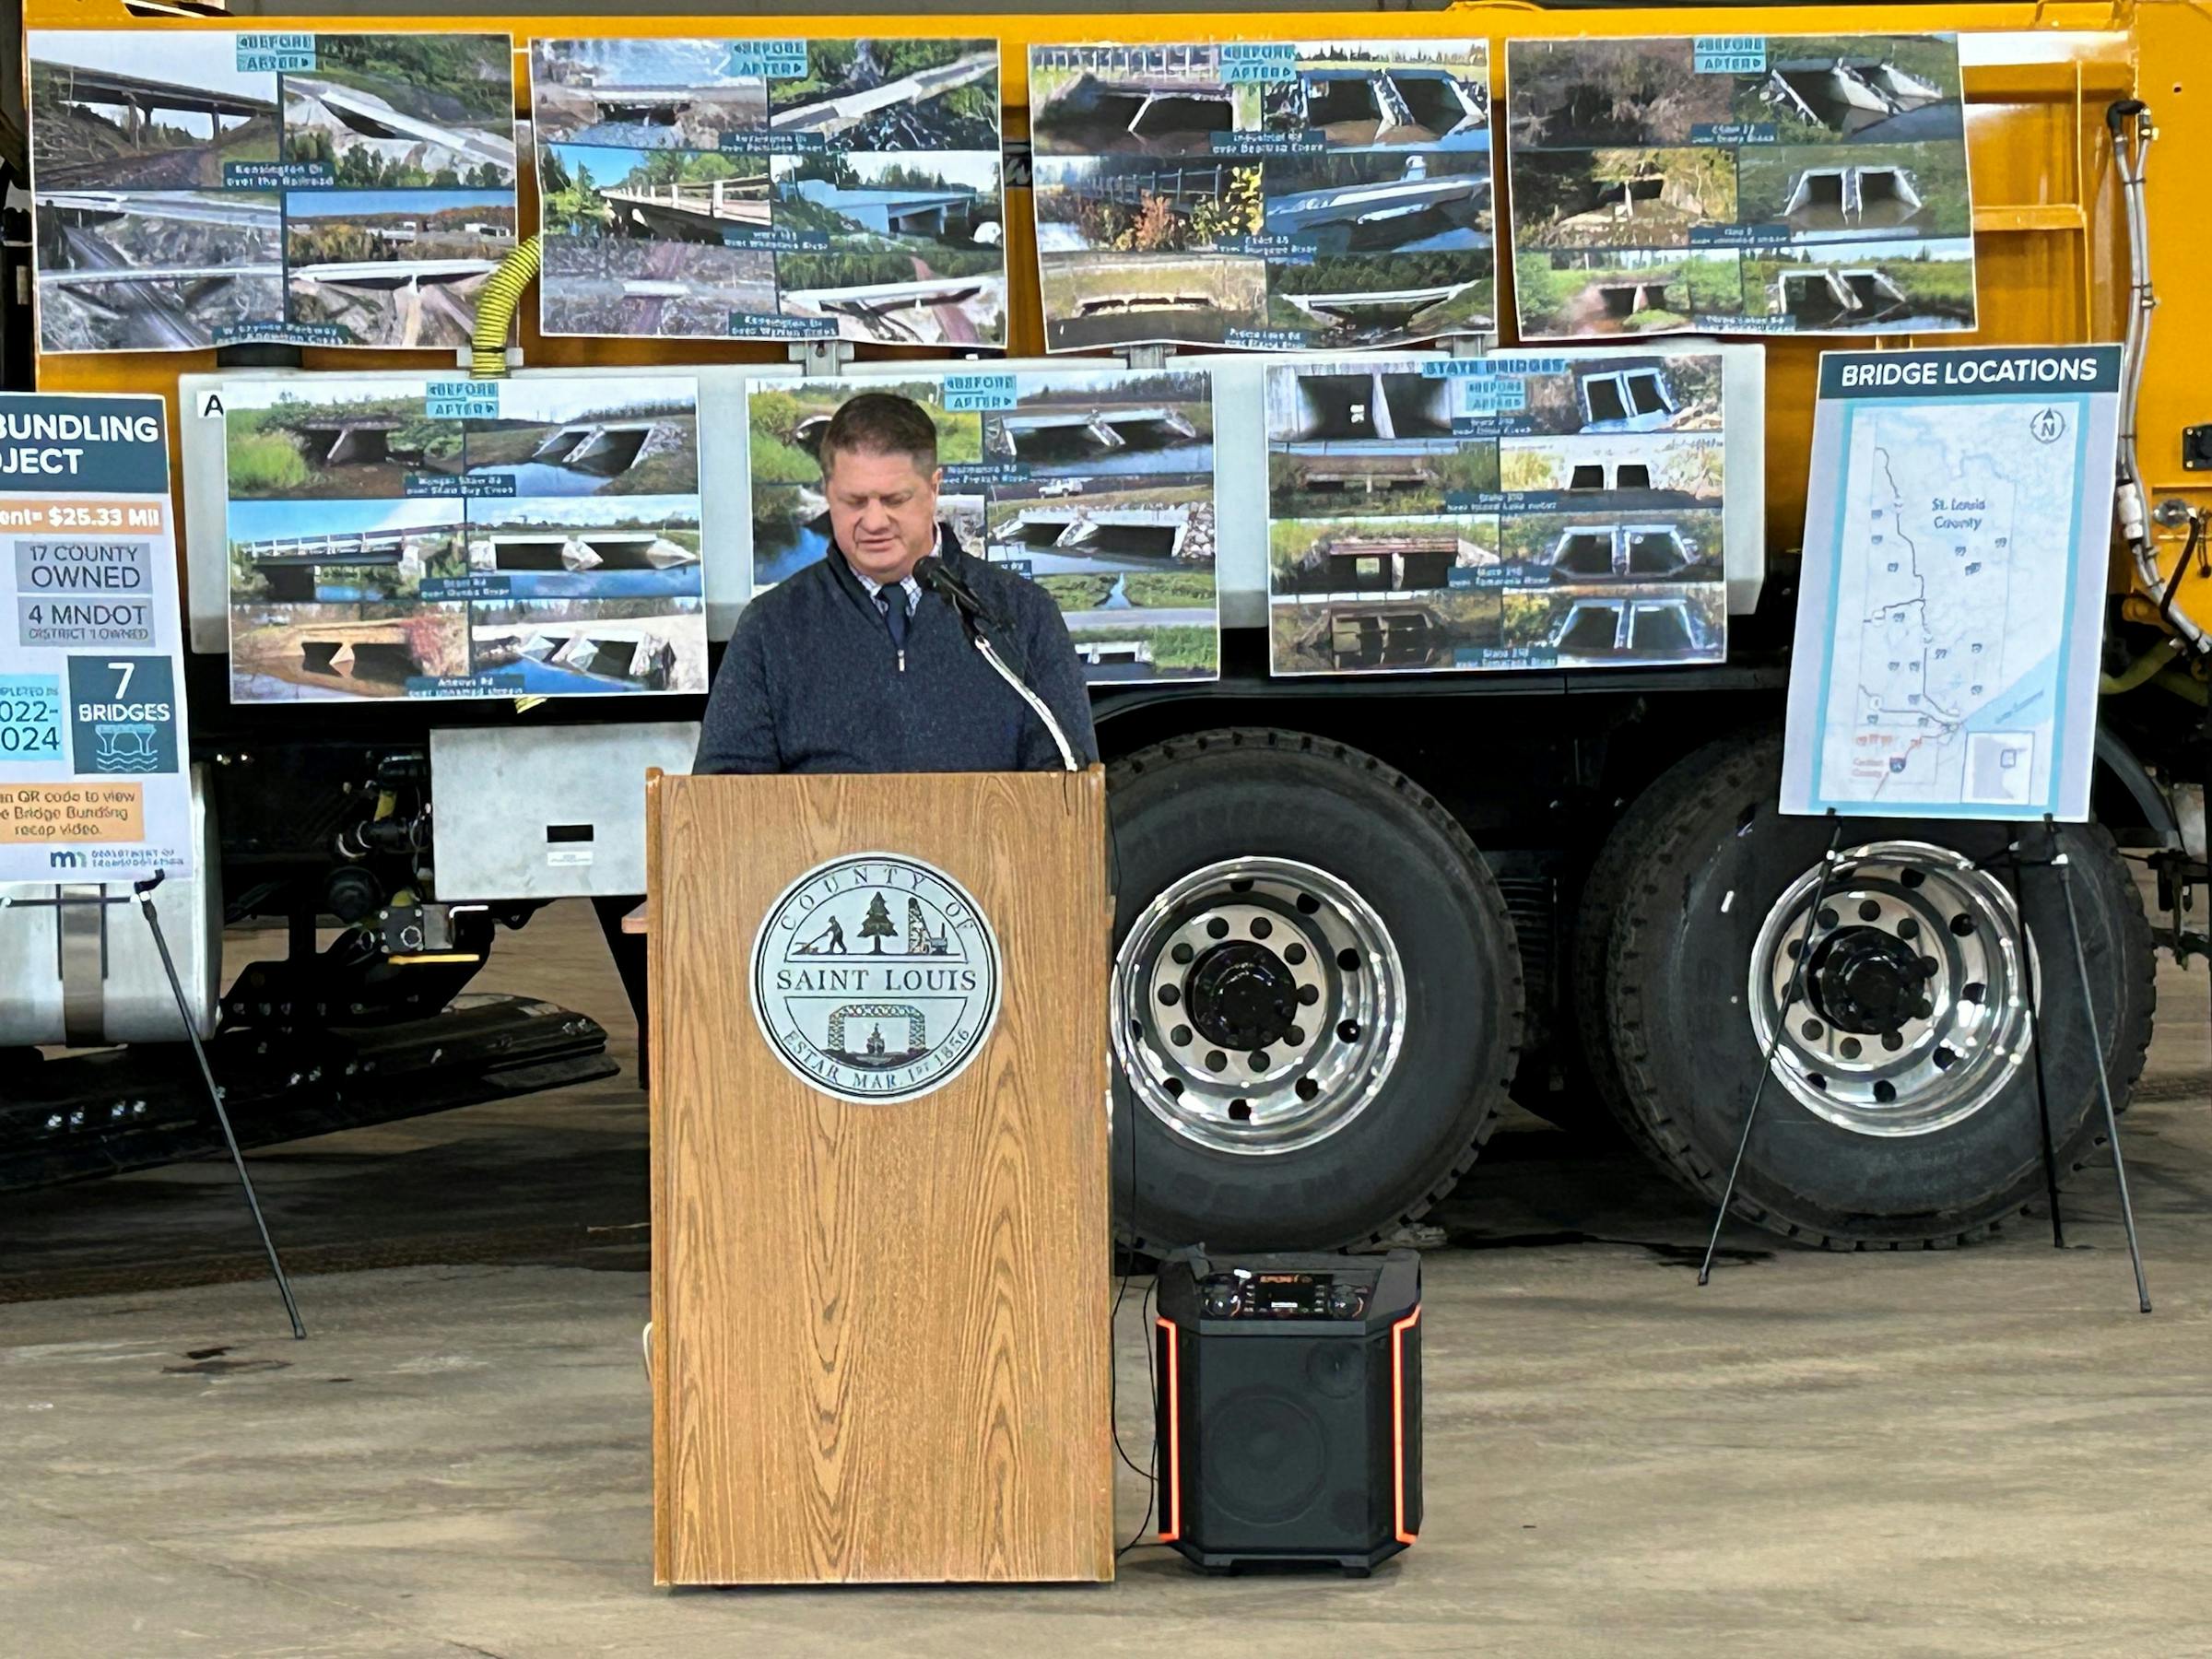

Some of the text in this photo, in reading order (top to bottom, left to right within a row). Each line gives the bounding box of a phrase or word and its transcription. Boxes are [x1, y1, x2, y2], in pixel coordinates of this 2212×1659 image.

[1841, 358, 2098, 386] BRIDGE LOCATIONS
[204, 394, 224, 417] A
[53, 545, 139, 562] COUNTY
[31, 565, 141, 589] OWNED
[29, 604, 147, 626] 4 MNDOT
[108, 662, 135, 700] 7
[78, 703, 171, 722] BRIDGES
[1, 726, 60, 751] 024
[18, 790, 41, 803] QR
[44, 790, 81, 804] code
[85, 790, 100, 803] to
[103, 790, 135, 803] view
[15, 806, 61, 821] Bridge
[781, 865, 975, 932] COUNTY OF
[776, 969, 977, 991] SAINT LOUIS
